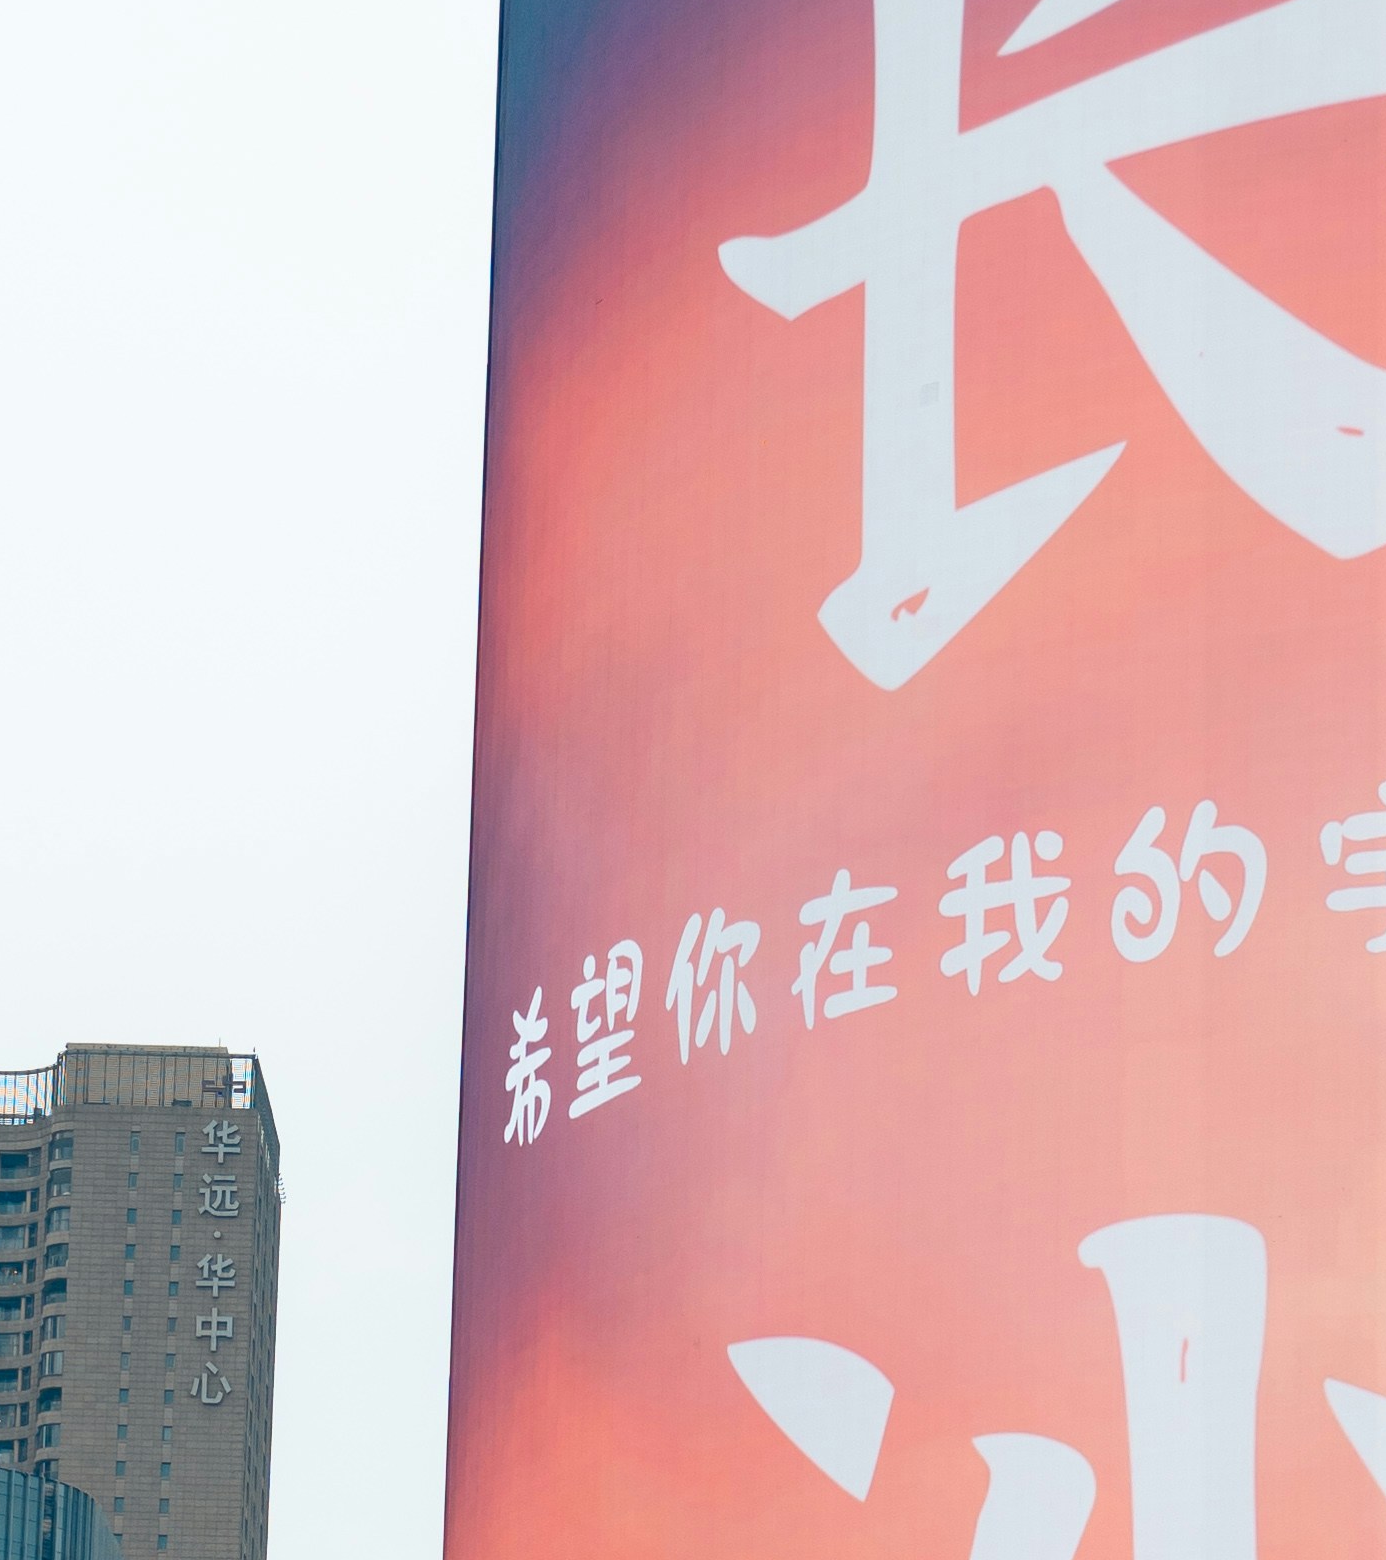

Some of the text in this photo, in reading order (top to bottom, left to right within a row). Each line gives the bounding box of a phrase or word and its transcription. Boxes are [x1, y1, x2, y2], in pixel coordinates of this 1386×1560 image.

[190, 1118, 243, 1406] 华远·华中心
